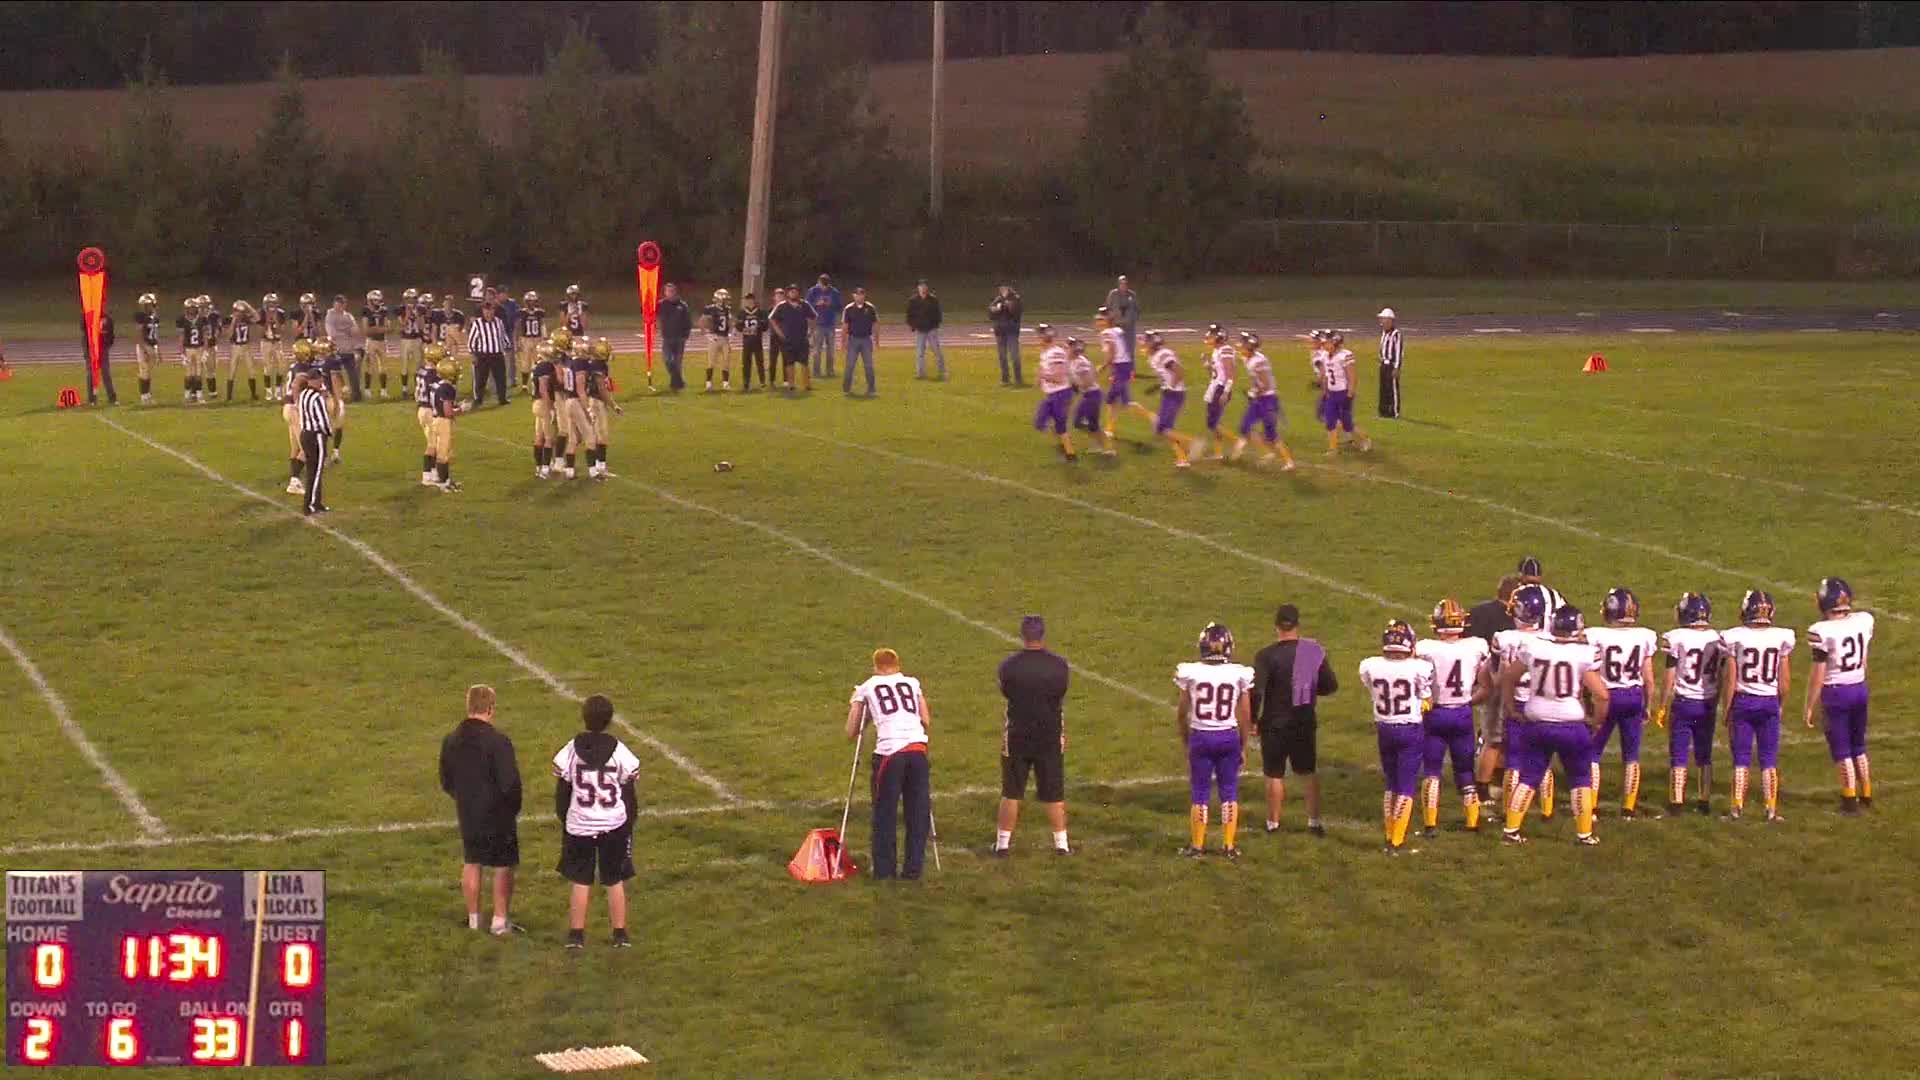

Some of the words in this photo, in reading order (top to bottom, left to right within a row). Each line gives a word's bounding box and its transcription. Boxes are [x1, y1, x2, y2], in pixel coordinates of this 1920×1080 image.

[470, 277, 484, 298] 2
[190, 330, 199, 345] 2
[236, 326, 248, 342] 17
[525, 320, 539, 336] 10
[718, 316, 726, 331] 3
[1329, 369, 1336, 385] 3
[60, 389, 76, 407] 40
[1605, 645, 1641, 682] 64
[1686, 648, 1719, 683] 34
[1741, 648, 1778, 683] 20
[1840, 633, 1866, 672] 21
[1445, 659, 1464, 697] 4
[1533, 659, 1573, 698] 70
[875, 682, 916, 715] 88
[1195, 683, 1234, 721] 28
[1373, 679, 1412, 715] 32
[575, 764, 617, 808] 55
